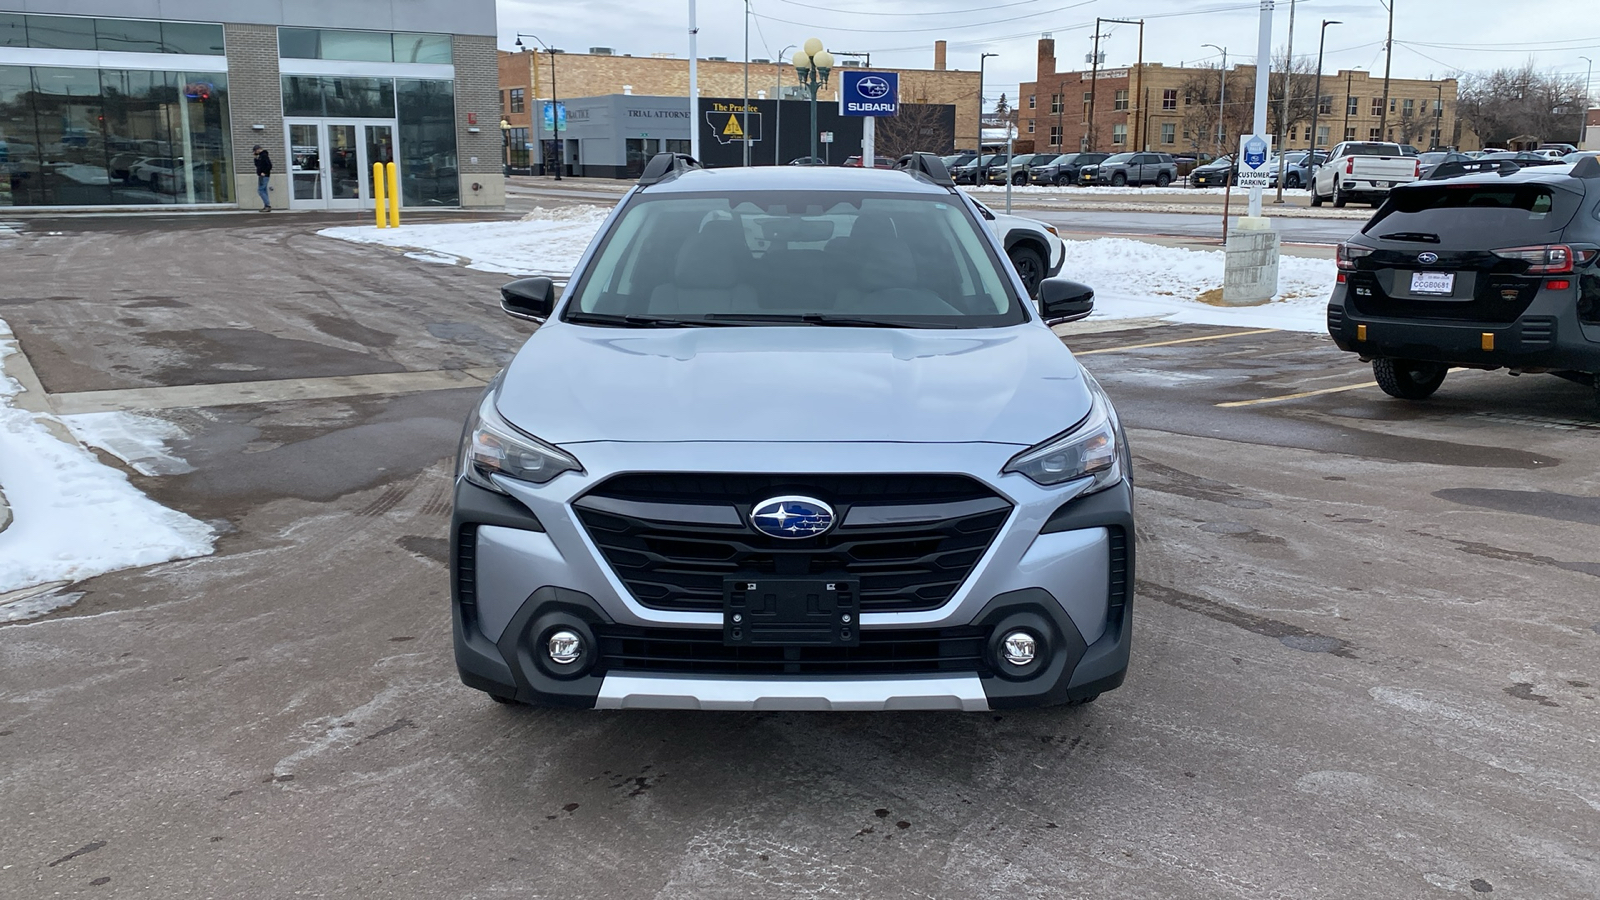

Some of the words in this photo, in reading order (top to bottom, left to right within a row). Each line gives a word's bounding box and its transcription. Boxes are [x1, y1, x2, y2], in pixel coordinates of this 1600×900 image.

[713, 102, 728, 111] The
[729, 103, 758, 112] Pracice
[848, 102, 895, 112] SUBARU
[628, 110, 652, 118] TRIAL
[1413, 281, 1449, 289] CCGB0681
